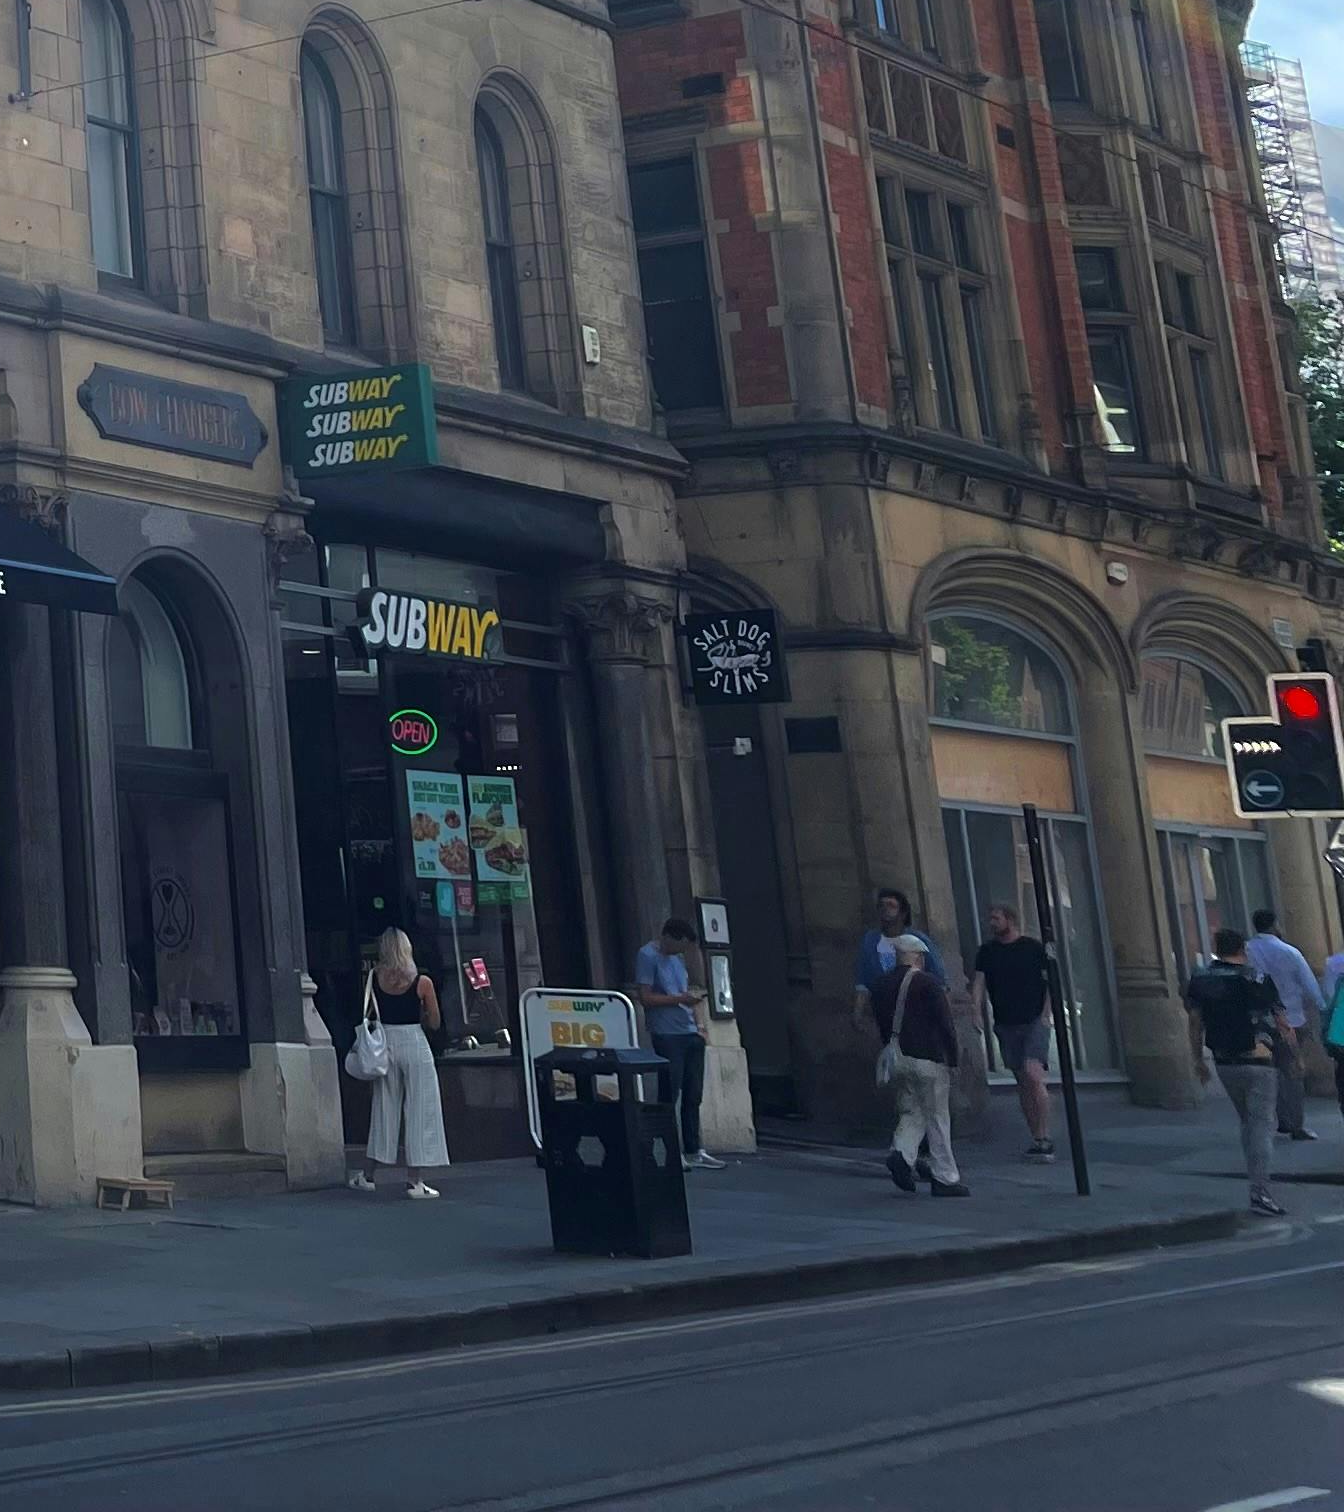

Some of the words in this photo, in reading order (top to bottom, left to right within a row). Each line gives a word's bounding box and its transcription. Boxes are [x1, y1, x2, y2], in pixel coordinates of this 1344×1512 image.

[303, 373, 402, 408] SUBWAY
[305, 403, 406, 438] SUBWAY
[308, 433, 409, 467] SUBWAY
[362, 591, 500, 658] SUBWAY
[693, 619, 729, 651] SALT
[738, 619, 771, 651] DOG
[392, 719, 430, 745] OPEN
[547, 999, 605, 1012] SUBWAY
[550, 1021, 605, 1047] BIG
